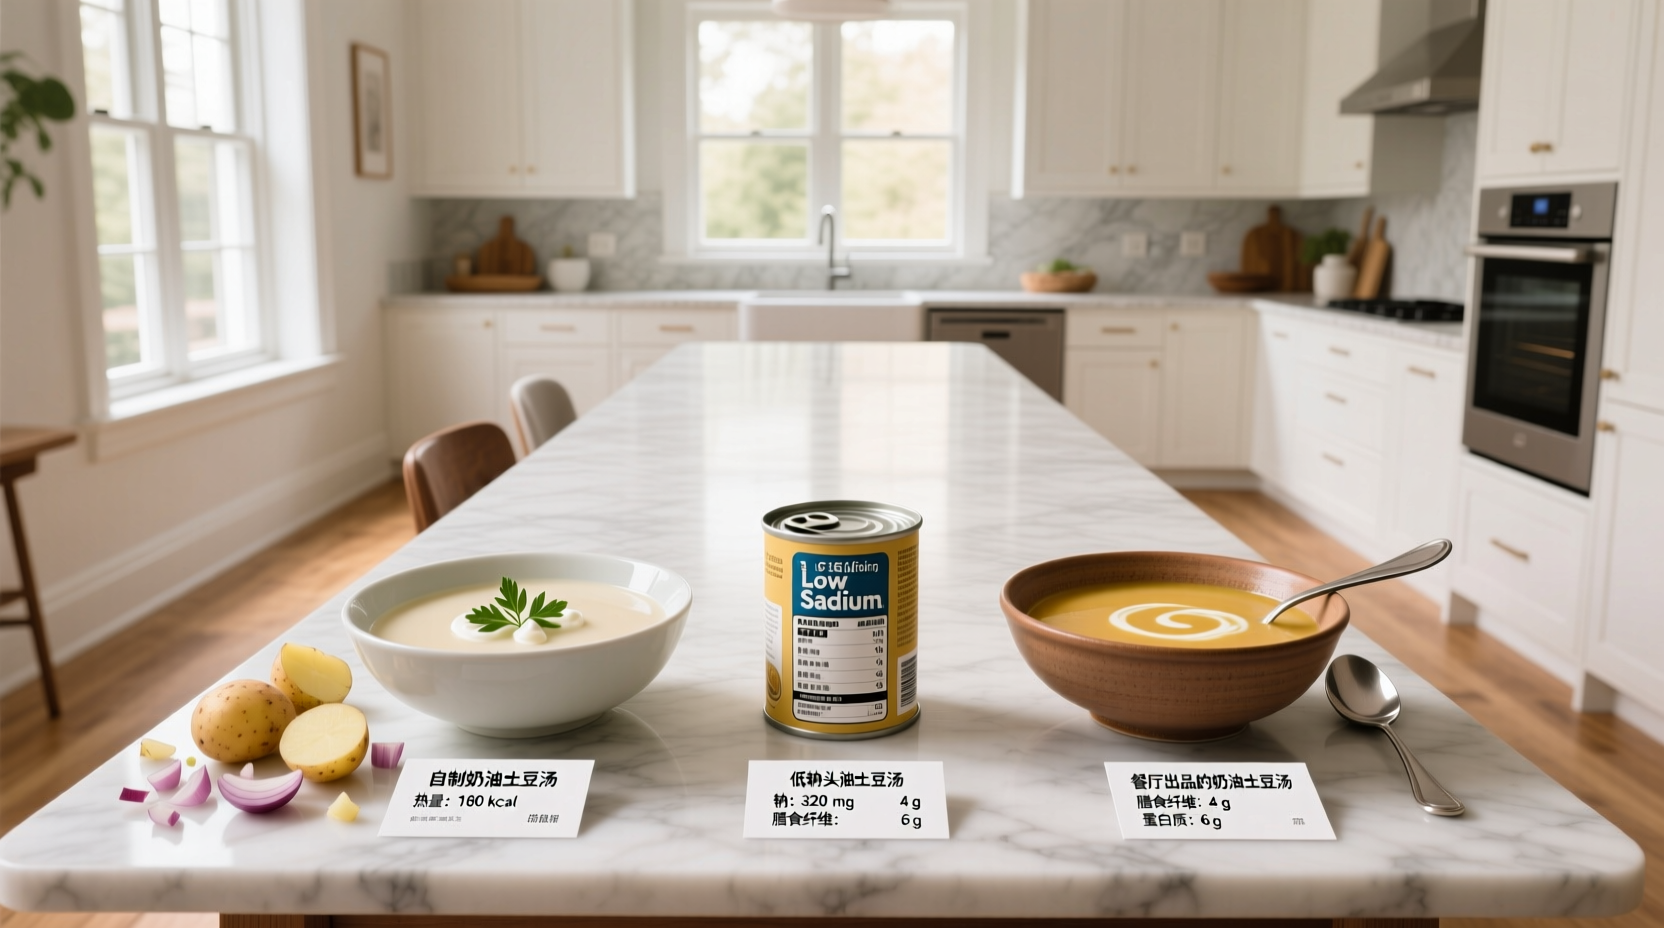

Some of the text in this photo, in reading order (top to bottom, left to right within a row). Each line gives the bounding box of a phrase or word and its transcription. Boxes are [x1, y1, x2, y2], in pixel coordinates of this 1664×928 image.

[801, 563, 848, 590] Low
[429, 769, 558, 788] 自制奶油土豆汤
[1130, 772, 1293, 791] 餐厅出品的奶油土豆汤
[487, 795, 518, 808] kcal
[800, 794, 828, 807] 320
[832, 798, 855, 811] mg
